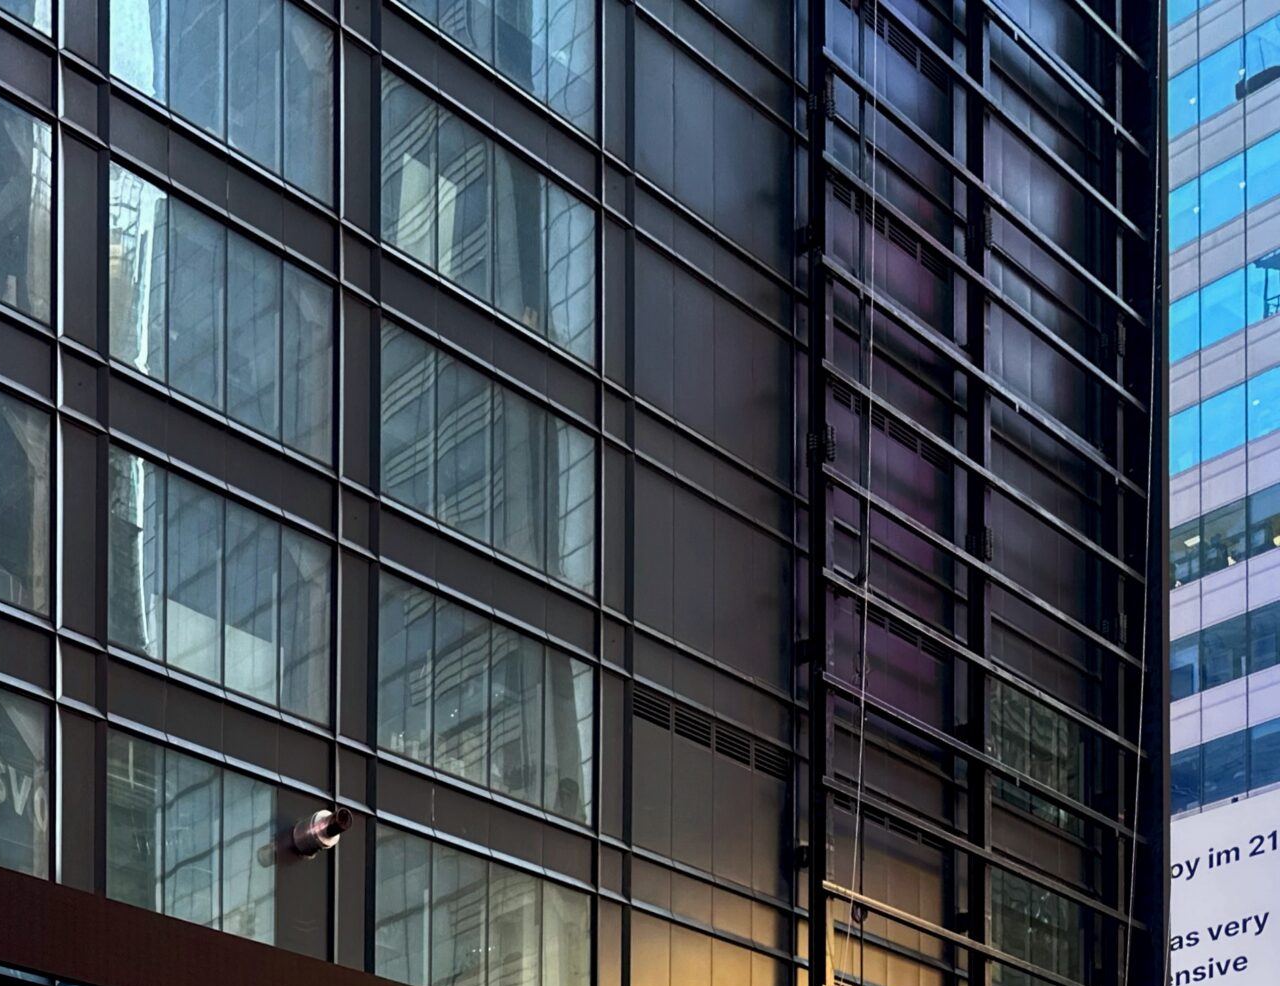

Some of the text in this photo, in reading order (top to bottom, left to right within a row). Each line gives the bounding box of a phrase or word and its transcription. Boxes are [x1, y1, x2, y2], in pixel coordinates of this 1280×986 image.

[1170, 829, 1277, 880] oy im 21
[1169, 911, 1269, 952] as very
[1170, 955, 1248, 986] nsive
